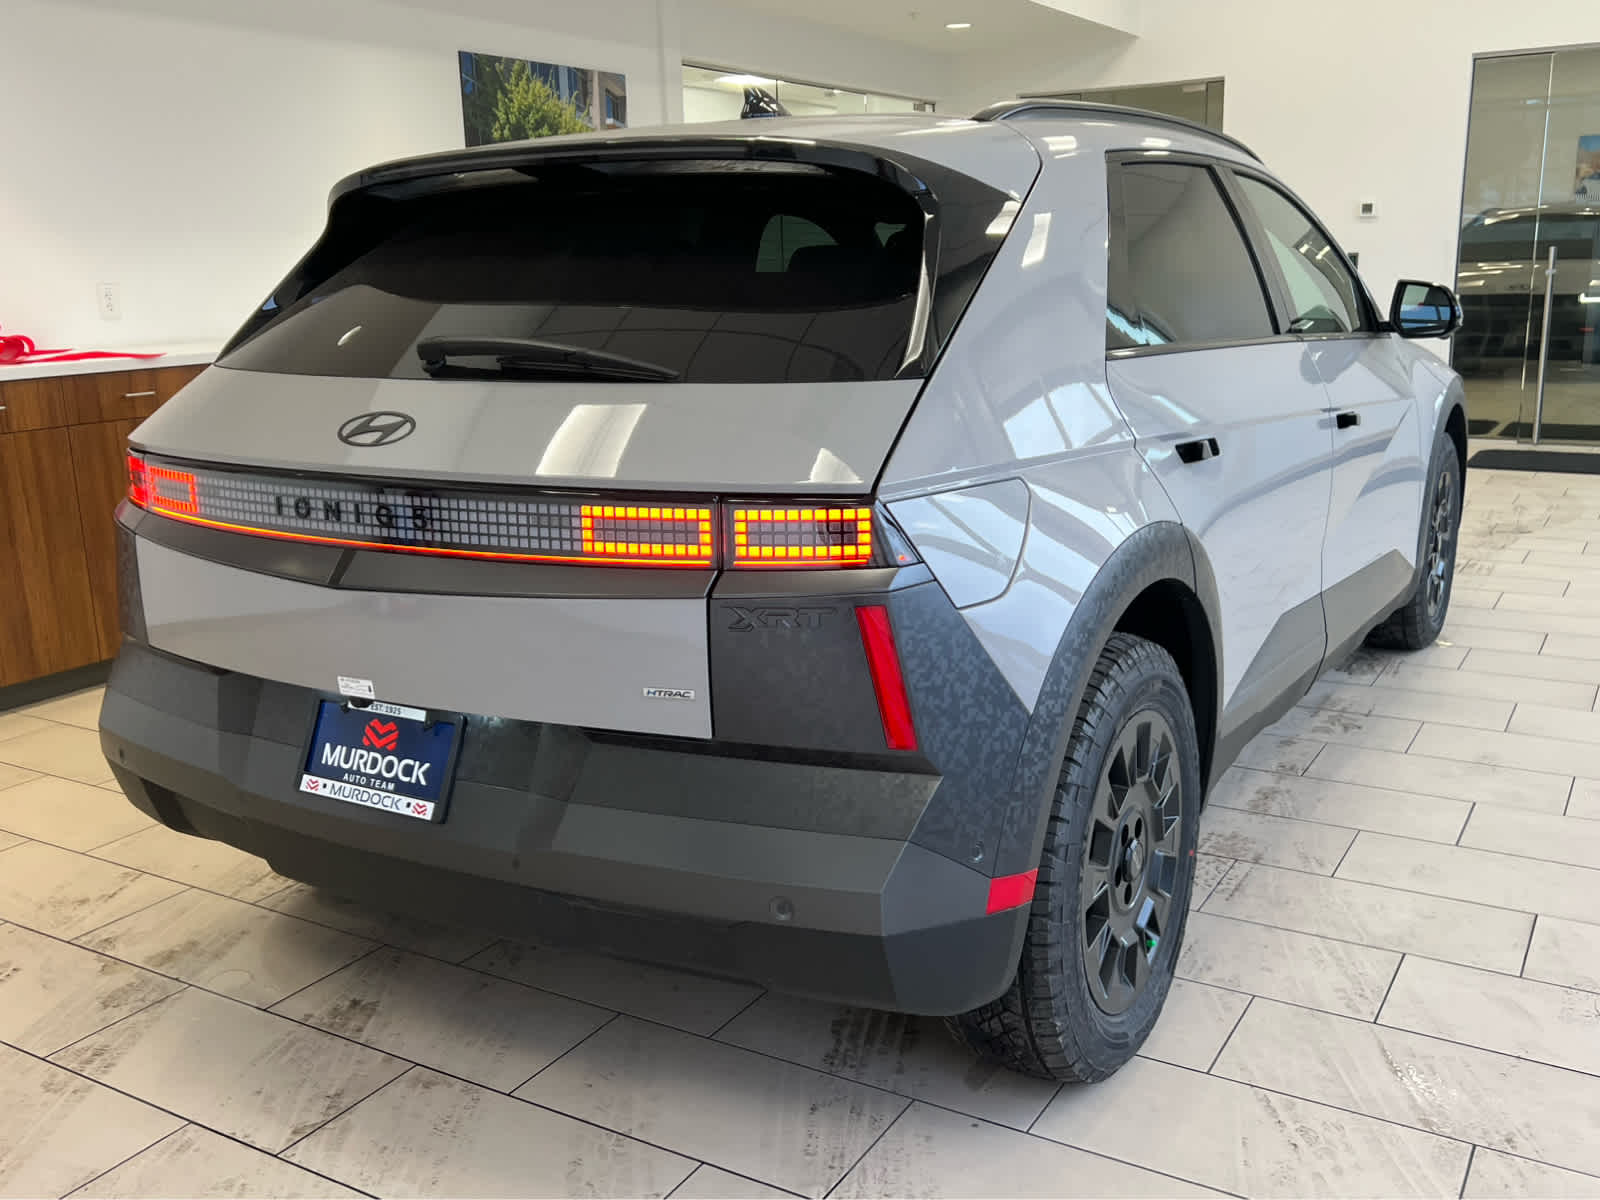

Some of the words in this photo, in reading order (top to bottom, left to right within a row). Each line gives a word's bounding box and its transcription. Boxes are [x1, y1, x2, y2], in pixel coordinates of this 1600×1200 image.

[275, 495, 394, 529] IONIQ
[413, 506, 427, 529] 5
[720, 606, 838, 632] XRT
[647, 688, 691, 698] HTRAC
[321, 742, 431, 786] MURDOCK
[343, 773, 366, 785] AUTO
[370, 778, 395, 791] TEAM
[329, 784, 402, 811] MURDOCK
